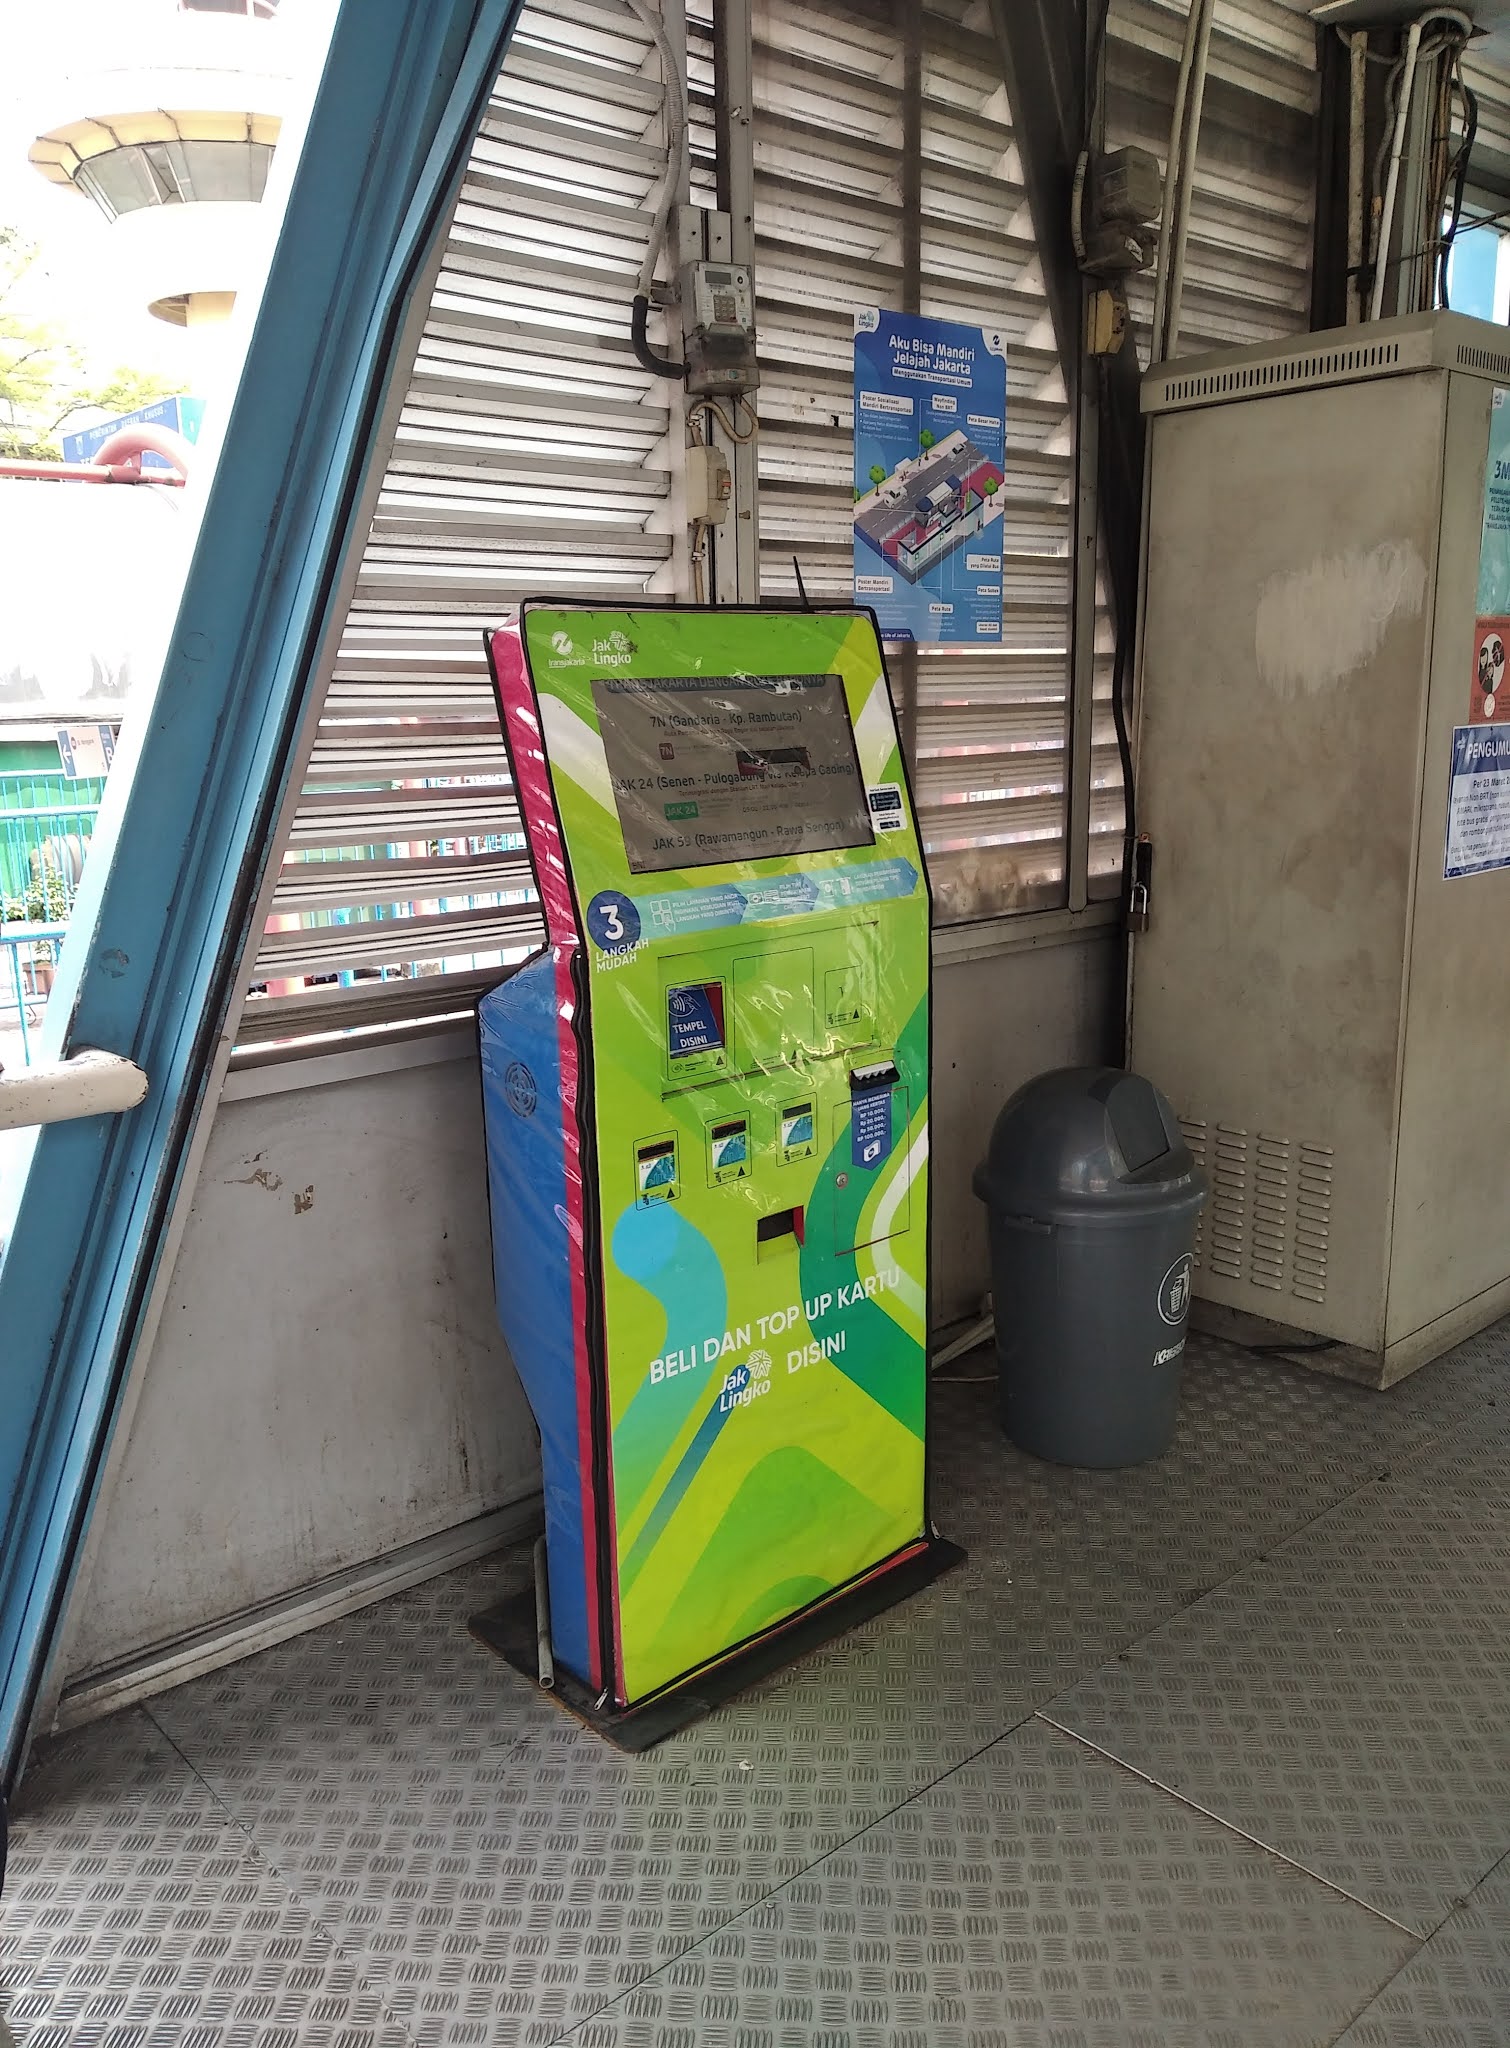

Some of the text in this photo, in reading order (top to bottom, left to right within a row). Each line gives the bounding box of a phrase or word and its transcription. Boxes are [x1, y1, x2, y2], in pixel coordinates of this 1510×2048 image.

[889, 334, 975, 361] Aku Bisa Mandiri
[894, 350, 971, 375] Jelajah Jakarta
[894, 368, 971, 386] Menggunakan Transportasi Umum
[592, 639, 611, 652] Jak
[549, 658, 585, 668] transjakarta
[593, 652, 632, 667] Lingko
[649, 716, 666, 727] 7N
[670, 714, 720, 728] (Gandaria
[728, 712, 746, 725] Kp.
[749, 709, 803, 722] Rambutan)
[660, 746, 673, 756] 7N
[639, 778, 654, 790] 24
[656, 776, 695, 790] (Senen
[666, 805, 697, 816] JAK 24
[653, 838, 675, 850] JAK
[695, 829, 768, 848] (Rawamangun
[776, 825, 804, 837] Rawa
[805, 820, 846, 833] Sengon)
[599, 904, 624, 941] 3
[596, 938, 649, 961] LANGKAH
[596, 954, 637, 973] MUDAH
[672, 1020, 707, 1033] TEMPEL
[680, 1035, 708, 1047] DISINI
[650, 1265, 900, 1384] BELI DAN TOP UP KARTU
[787, 1330, 846, 1374] DISINI
[719, 1369, 747, 1394] Jak
[719, 1379, 770, 1412] Lingko
